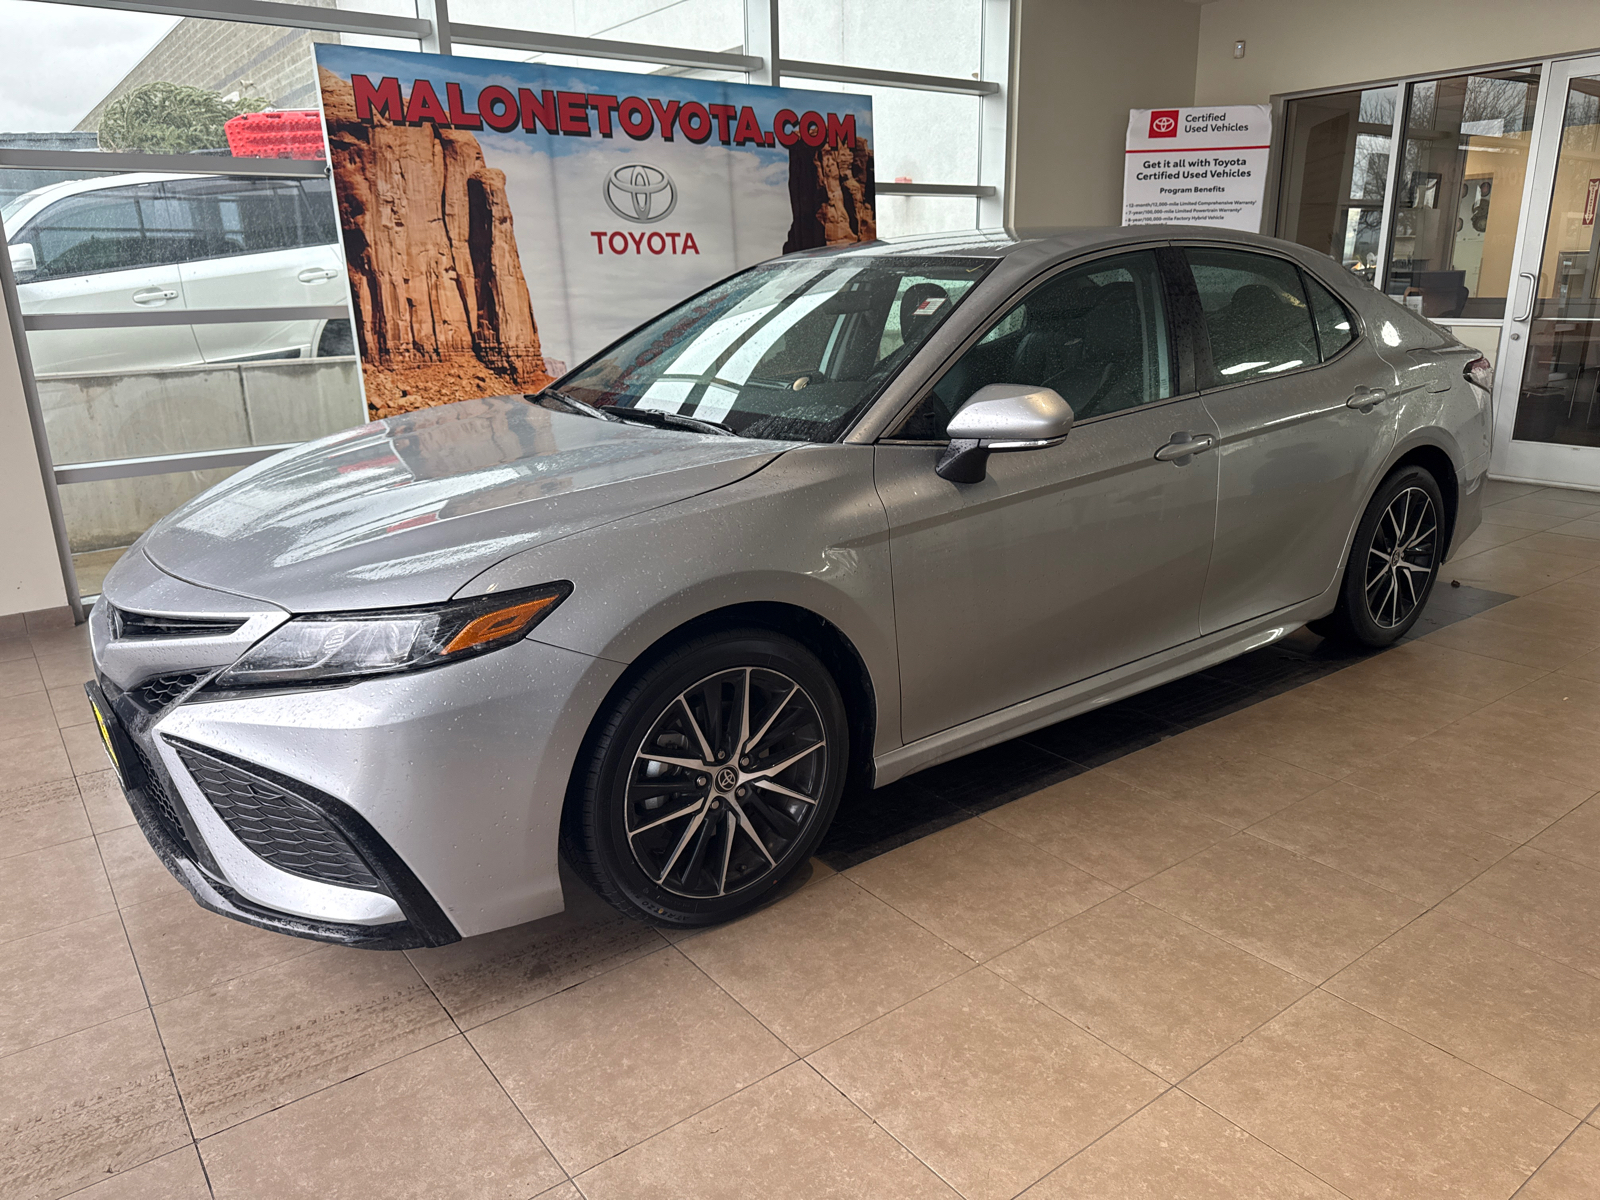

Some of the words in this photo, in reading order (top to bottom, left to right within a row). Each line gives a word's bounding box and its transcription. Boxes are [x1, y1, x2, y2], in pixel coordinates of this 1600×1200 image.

[351, 74, 857, 149] MALONETOYOTA.COM
[1185, 112, 1226, 123] Certified
[1184, 124, 1208, 133] Used
[1210, 123, 1249, 132] Vehicles
[1143, 160, 1161, 169] Get
[1163, 160, 1172, 168] it
[1173, 159, 1186, 168] all
[1188, 158, 1211, 168] with
[1213, 158, 1247, 168] Toyota
[1136, 170, 1180, 180] Certified
[1182, 170, 1208, 179] Used
[1210, 169, 1252, 178] Vehicles
[1160, 187, 1192, 195] Program
[590, 230, 700, 256] TOYOTA
